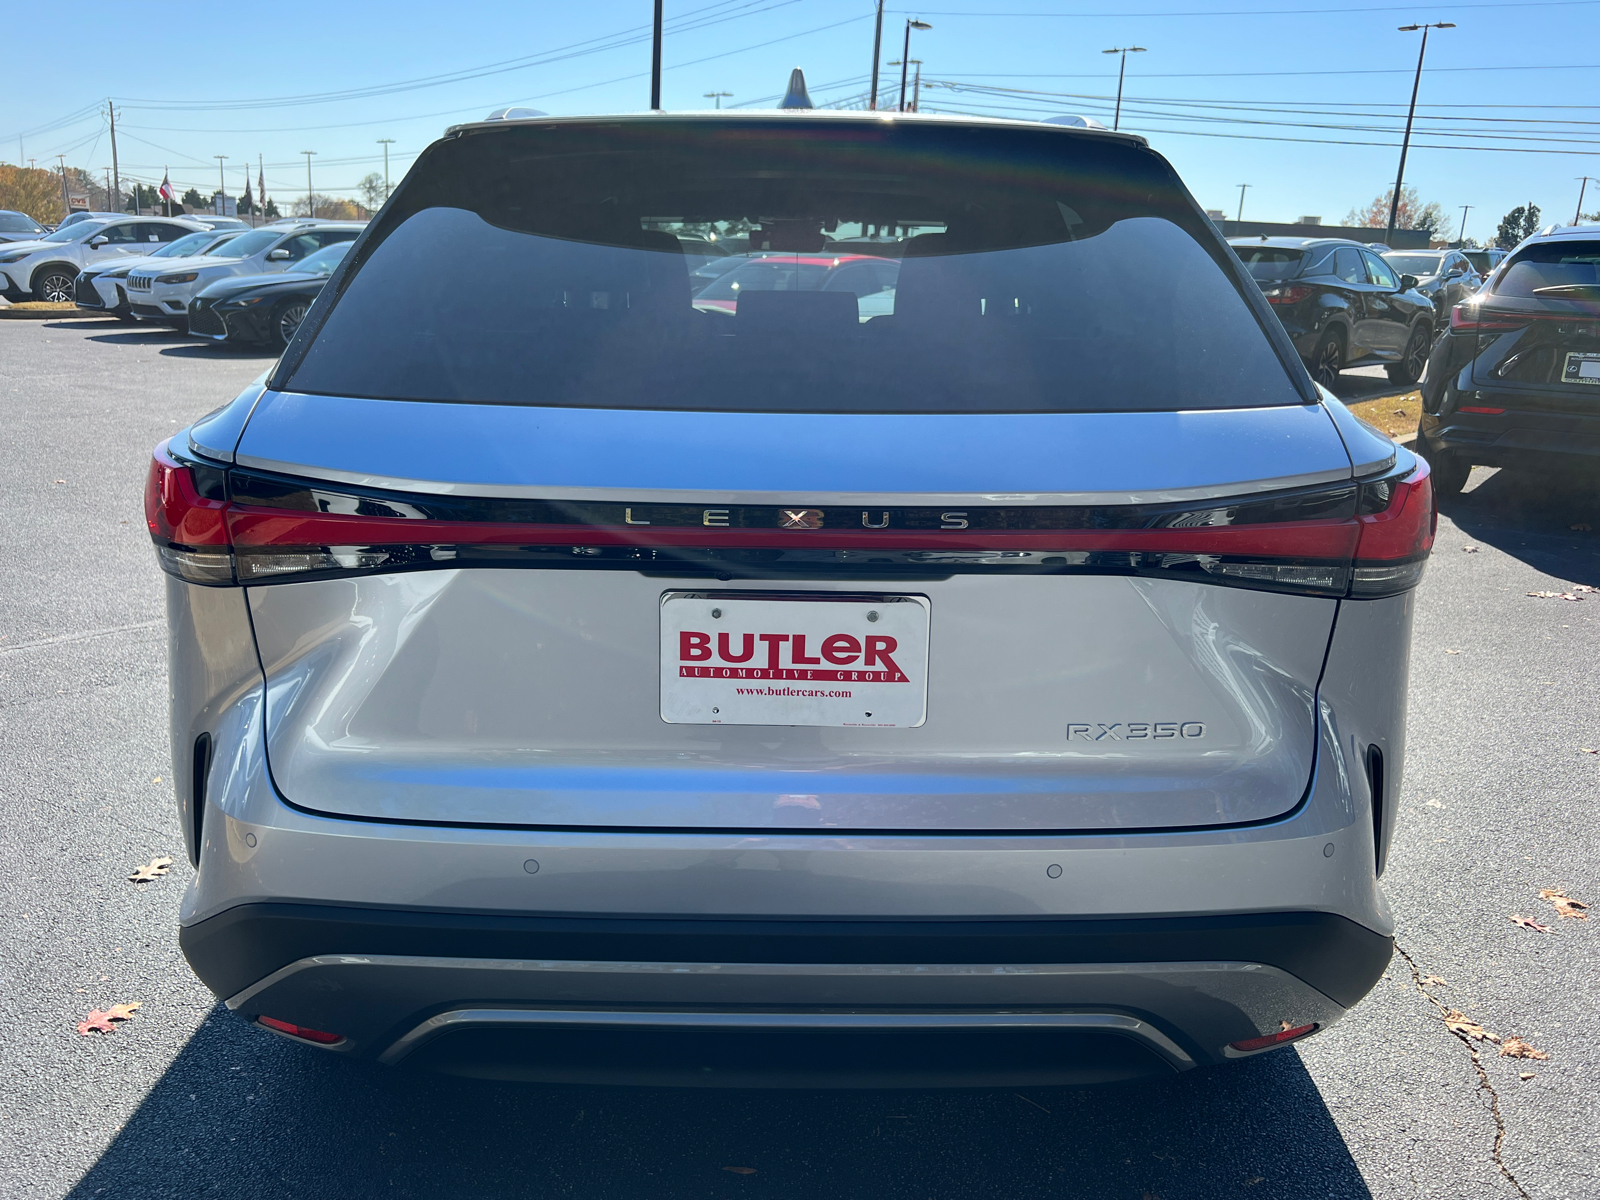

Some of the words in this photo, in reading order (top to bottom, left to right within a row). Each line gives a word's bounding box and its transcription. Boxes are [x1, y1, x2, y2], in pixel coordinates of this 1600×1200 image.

[624, 507, 969, 530] LEXUS
[680, 667, 814, 680] AUTOMOTIVE
[837, 671, 901, 681] GROUP
[736, 686, 852, 698] www.butlercars.com
